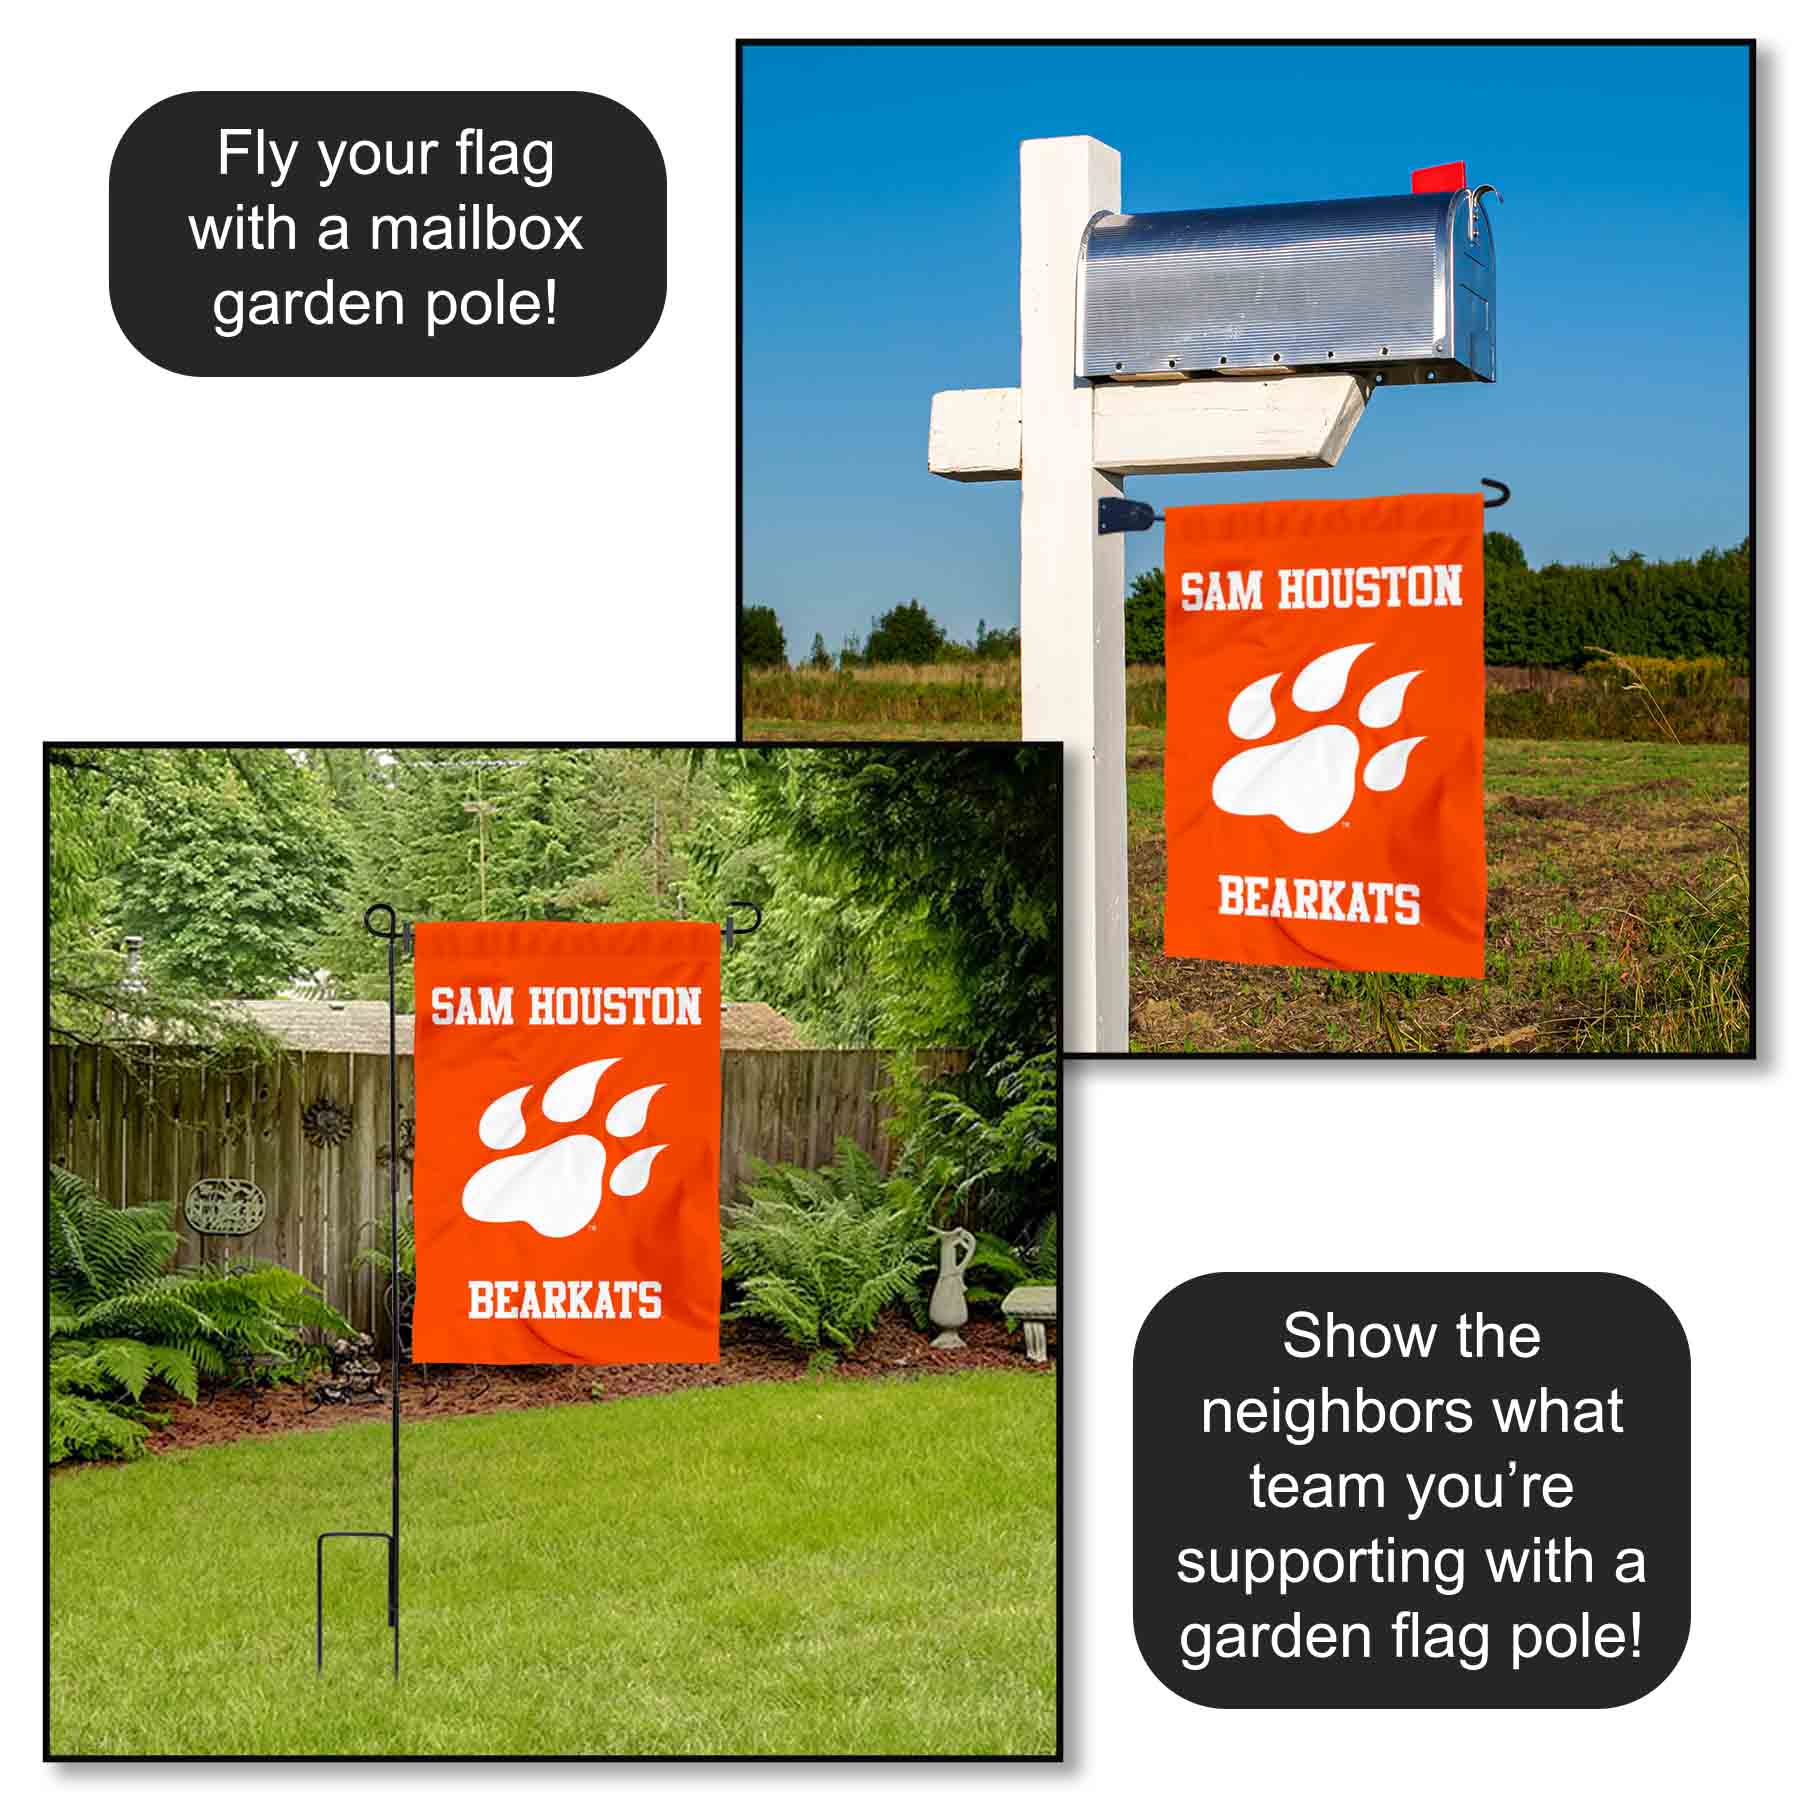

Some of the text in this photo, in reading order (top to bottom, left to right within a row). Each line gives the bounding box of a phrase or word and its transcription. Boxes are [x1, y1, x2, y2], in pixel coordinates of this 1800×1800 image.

[1181, 564, 1463, 611] SAM HOUSTON
[1218, 874, 1420, 926] BEARKATS
[431, 986, 702, 1025] SAM HOUSTON
[468, 1280, 662, 1320] BEARKATS
